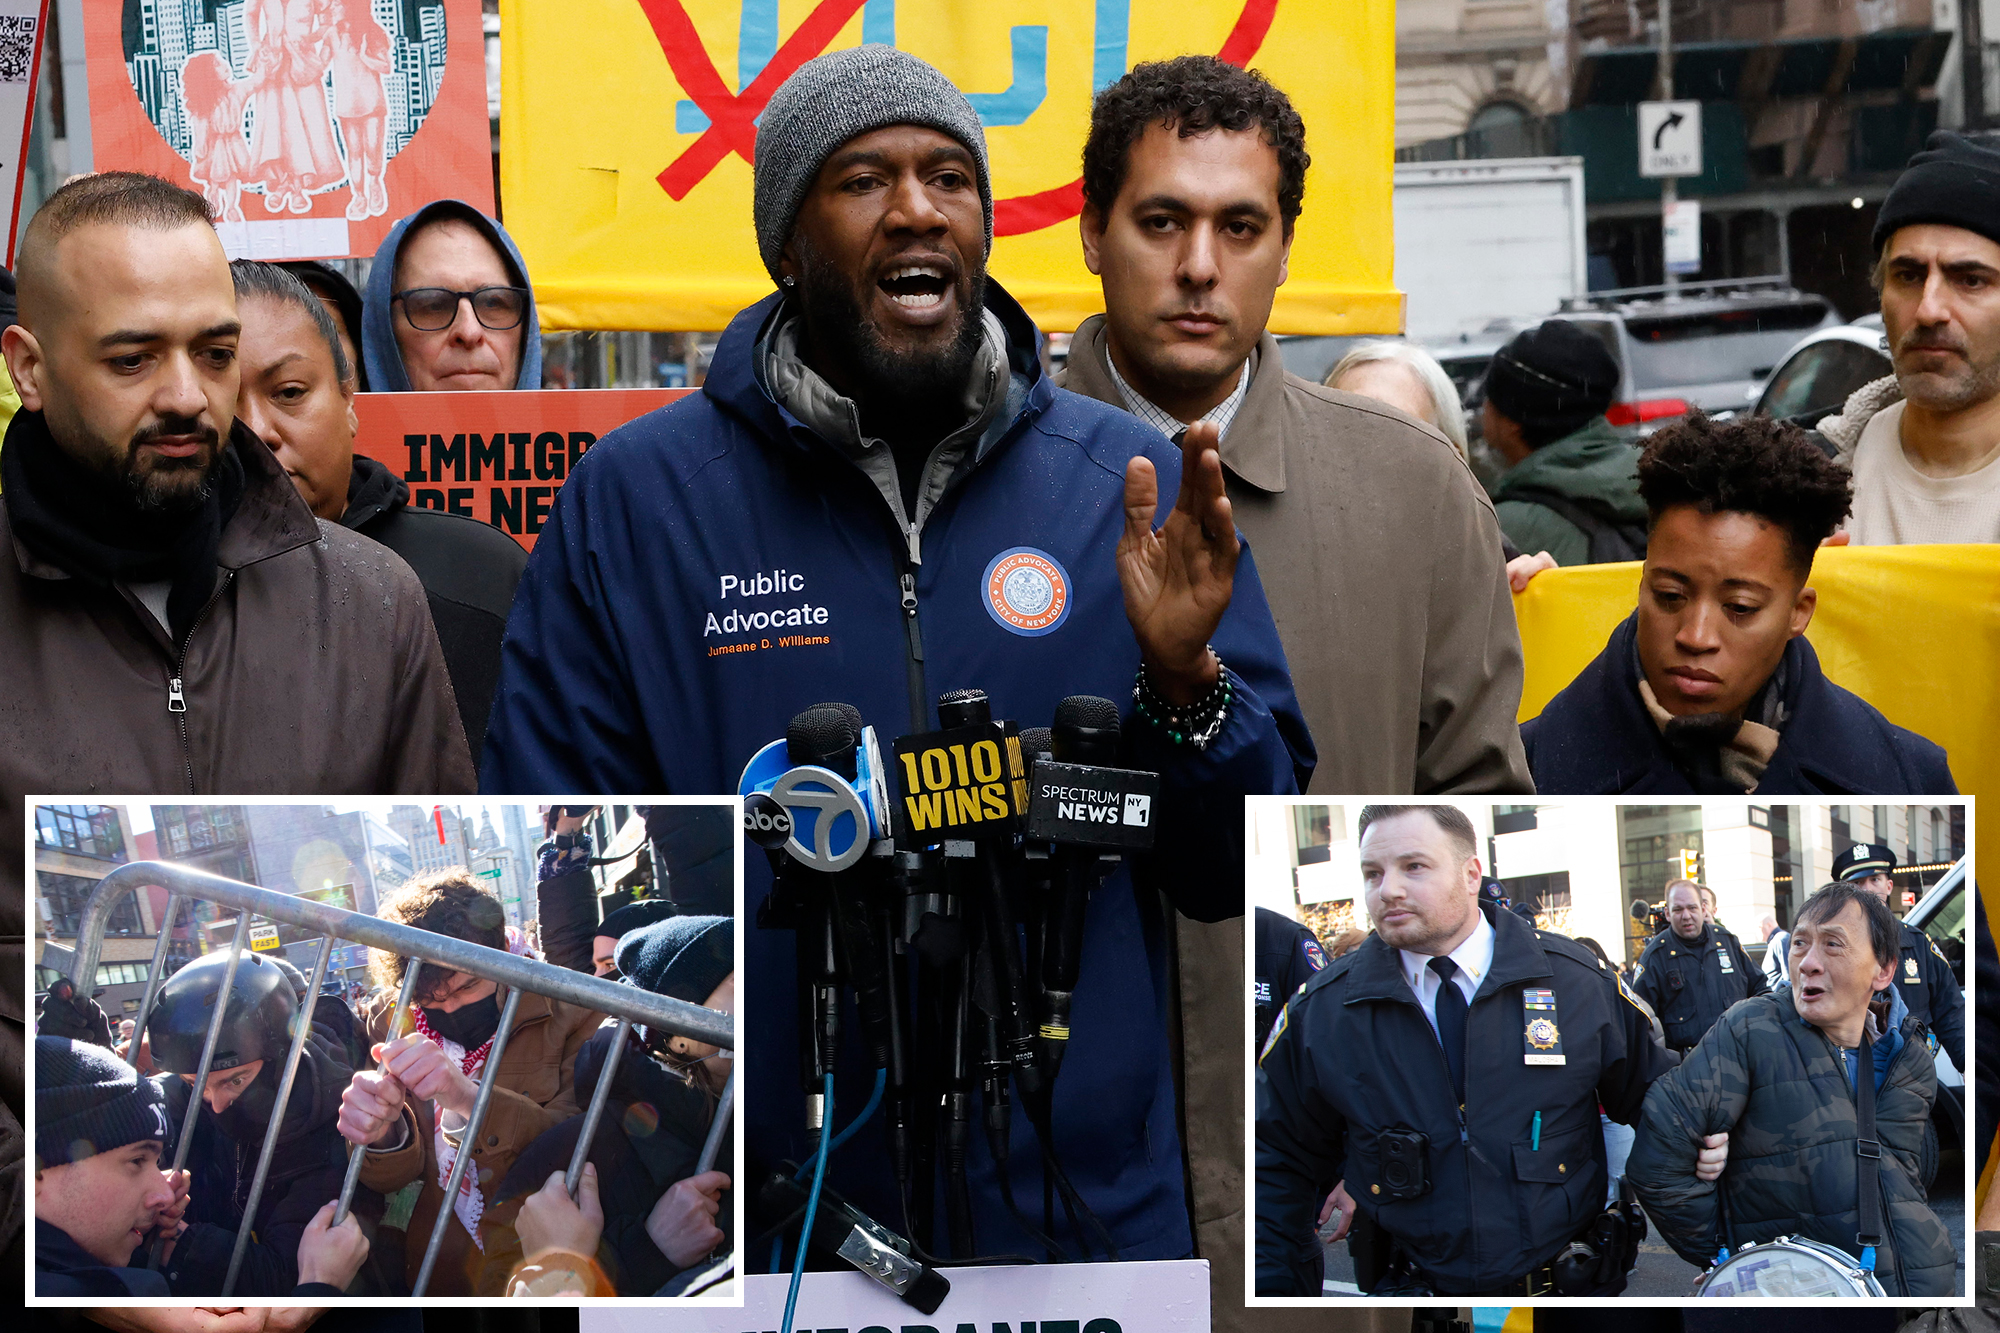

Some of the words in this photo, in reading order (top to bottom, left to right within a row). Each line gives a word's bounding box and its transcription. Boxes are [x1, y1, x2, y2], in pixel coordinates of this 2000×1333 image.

[994, 559, 1016, 583] PUBLIC
[1018, 557, 1058, 582] ADVOCATE
[720, 569, 805, 599] Public
[703, 603, 829, 637] Advocate
[995, 598, 1011, 617] CITY
[1011, 615, 1024, 625] OF
[1026, 617, 1046, 627] NEW
[1046, 598, 1063, 620] YORK
[708, 642, 757, 657] Jumaane
[761, 638, 773, 649] D.
[778, 635, 830, 648] Williams
[900, 739, 1002, 794] 1010
[1041, 784, 1120, 805] SPECTRUM
[1128, 797, 1142, 808] NY
[905, 782, 1009, 831] WINS
[1057, 802, 1119, 824] NEWS
[1139, 809, 1147, 823] 1
[744, 807, 790, 832] abc
[252, 928, 276, 938] PARK
[255, 938, 276, 949] FAST
